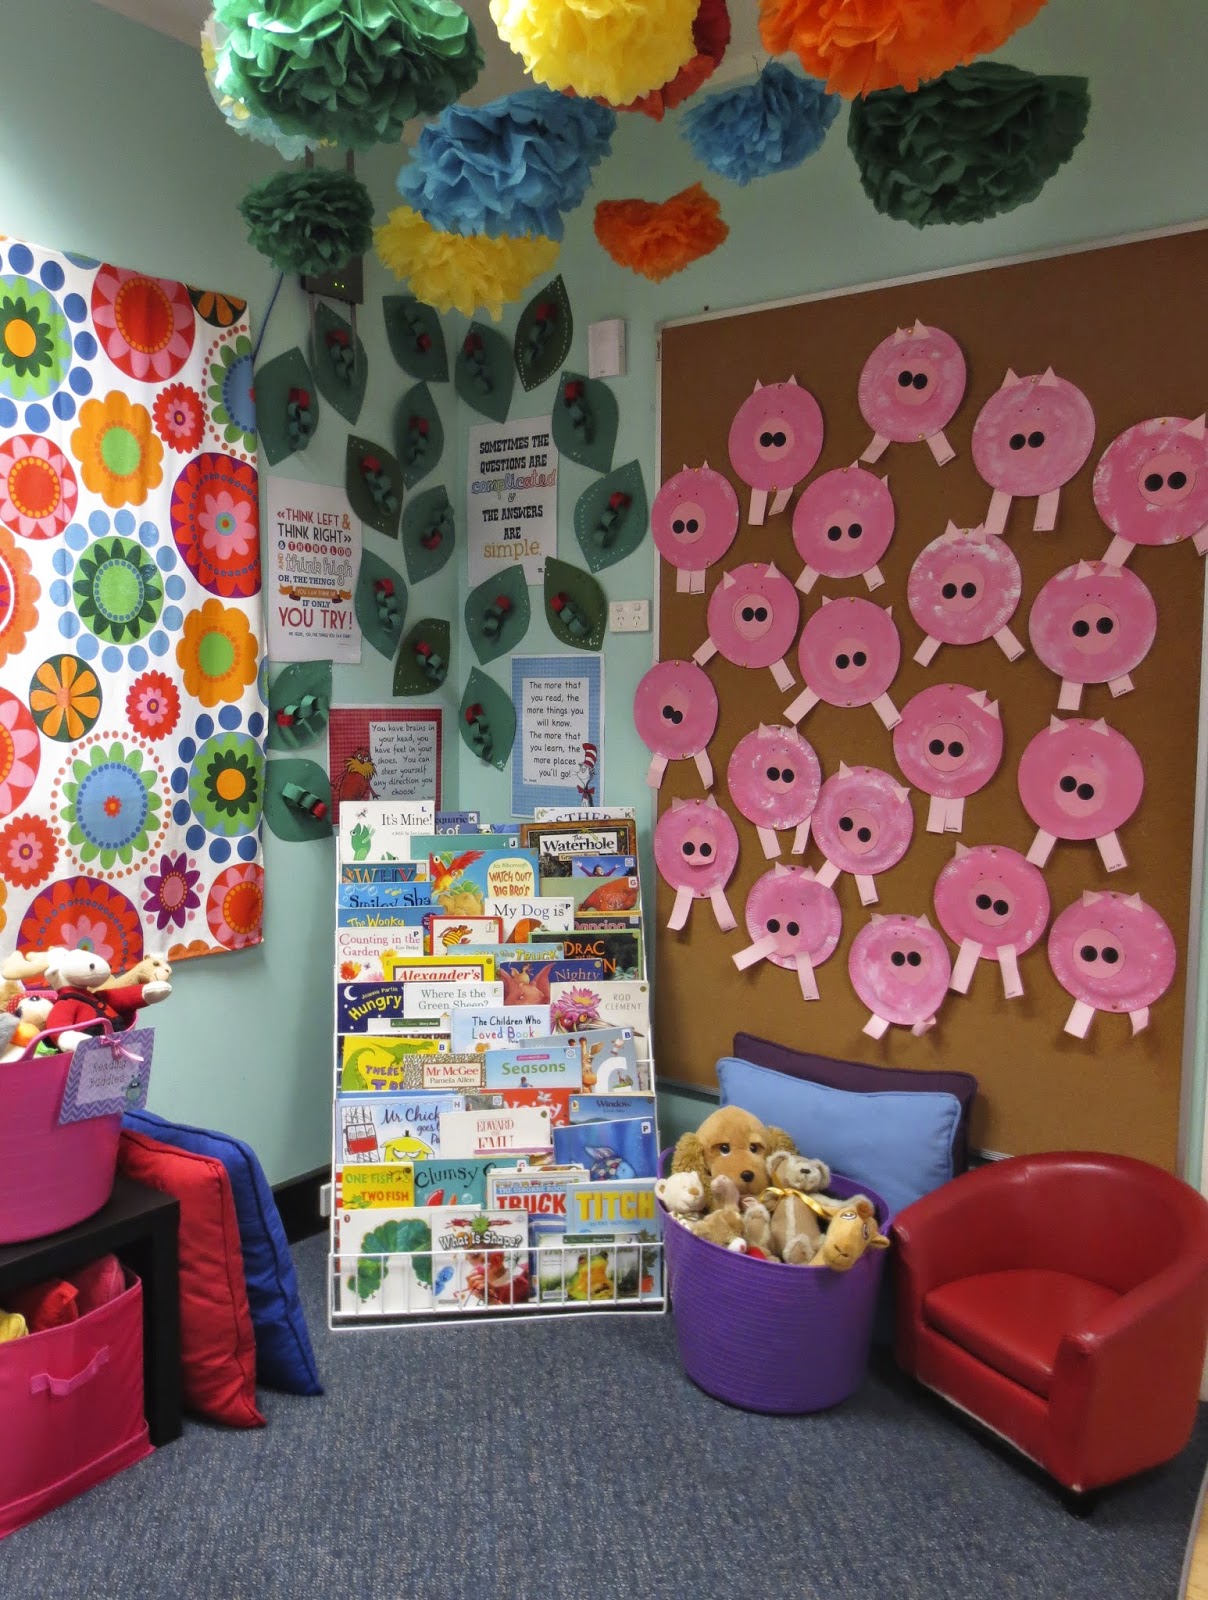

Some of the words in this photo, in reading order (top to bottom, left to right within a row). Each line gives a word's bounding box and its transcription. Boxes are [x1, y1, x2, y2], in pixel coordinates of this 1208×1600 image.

[480, 436, 529, 454] SOMETIMES
[532, 434, 549, 448] THE
[480, 456, 527, 475] QUESTIONS
[529, 454, 547, 468] ARE
[472, 469, 556, 500] complicated
[508, 493, 516, 502] &
[482, 509, 499, 522] THE
[501, 505, 543, 520] ANSWERS
[318, 512, 339, 526] LEFT
[342, 514, 351, 530] &
[278, 523, 309, 540] THINK
[504, 527, 521, 540] ARE
[288, 541, 328, 555] THINK
[330, 546, 352, 557] LOW
[484, 539, 542, 561] simple.
[286, 554, 322, 574] think
[323, 557, 353, 587] high
[278, 574, 292, 584] OH,
[293, 576, 308, 584] THE
[309, 577, 336, 586] THINGS
[279, 607, 313, 628] YOU
[320, 609, 352, 630] TRY!
[531, 695, 543, 703] you
[546, 694, 564, 703] read,
[567, 694, 580, 702] the
[527, 707, 544, 715] more
[546, 707, 568, 717] things
[571, 708, 584, 717] you
[388, 724, 404, 732] have
[406, 723, 426, 732] brains
[537, 719, 549, 727] will
[552, 719, 572, 727] know.
[379, 737, 394, 747] your
[397, 734, 415, 743] head,
[417, 736, 429, 746] you
[530, 731, 542, 739] The
[544, 732, 562, 740] more
[565, 732, 582, 740] that
[375, 746, 391, 754] have
[394, 745, 406, 755] feet
[418, 747, 433, 756] your
[530, 745, 542, 753] you
[544, 744, 565, 753] learn,
[568, 744, 581, 753] the
[378, 757, 398, 765] shoes.
[554, 757, 577, 766] places
[400, 765, 427, 778] yourself
[539, 768, 558, 778] you'll
[560, 770, 571, 780] go!
[374, 780, 387, 790] any
[389, 777, 420, 786] direction
[422, 778, 433, 788] you
[392, 787, 416, 796] choose!
[382, 814, 398, 826] It's
[400, 814, 432, 826] Mine!
[446, 824, 460, 835] of
[542, 837, 615, 853] Waterhole
[354, 868, 414, 883] WHY
[489, 870, 513, 883] WATCH
[493, 885, 508, 897] BIG
[510, 884, 530, 897] BRO'S
[404, 888, 431, 907] Sha
[494, 904, 517, 919] My
[522, 904, 550, 920] Dog
[554, 904, 565, 917] is
[347, 918, 366, 927] The
[366, 913, 405, 927] Wonky
[340, 934, 389, 946] Counting
[392, 934, 402, 944] in
[405, 932, 420, 944] the
[342, 946, 380, 957] Garden
[564, 940, 605, 956] DRAC
[398, 970, 481, 981] Alexander's
[555, 967, 600, 982] Nighty
[421, 989, 455, 999] Where
[457, 989, 468, 998] Is
[470, 989, 487, 998] the
[348, 996, 403, 1021] Hungry
[418, 1001, 450, 1010] Green
[472, 1016, 488, 1026] The
[490, 1016, 523, 1026] Children
[525, 1015, 542, 1025] Who
[472, 1027, 504, 1040] Loved
[366, 1065, 404, 1076] THERE'
[426, 1067, 441, 1076] Mr
[443, 1067, 479, 1076] McGee
[502, 1062, 566, 1076] Seasons
[90, 1074, 125, 1088] Buddies
[597, 1100, 632, 1108] Window
[381, 1109, 403, 1125] Mr
[405, 1106, 440, 1122] Chick
[417, 1124, 434, 1136] goes
[477, 1120, 515, 1133] EDWARD
[431, 1133, 440, 1145] Pa
[346, 1173, 368, 1184] ONE
[370, 1173, 394, 1184] FISH
[415, 1167, 479, 1188] Clumsy
[361, 1191, 389, 1201] TWO
[390, 1191, 409, 1201] FISH
[576, 1191, 655, 1222] TITCH
[439, 1232, 468, 1251] What
[472, 1232, 481, 1244] Is
[483, 1231, 523, 1249] Shape?
